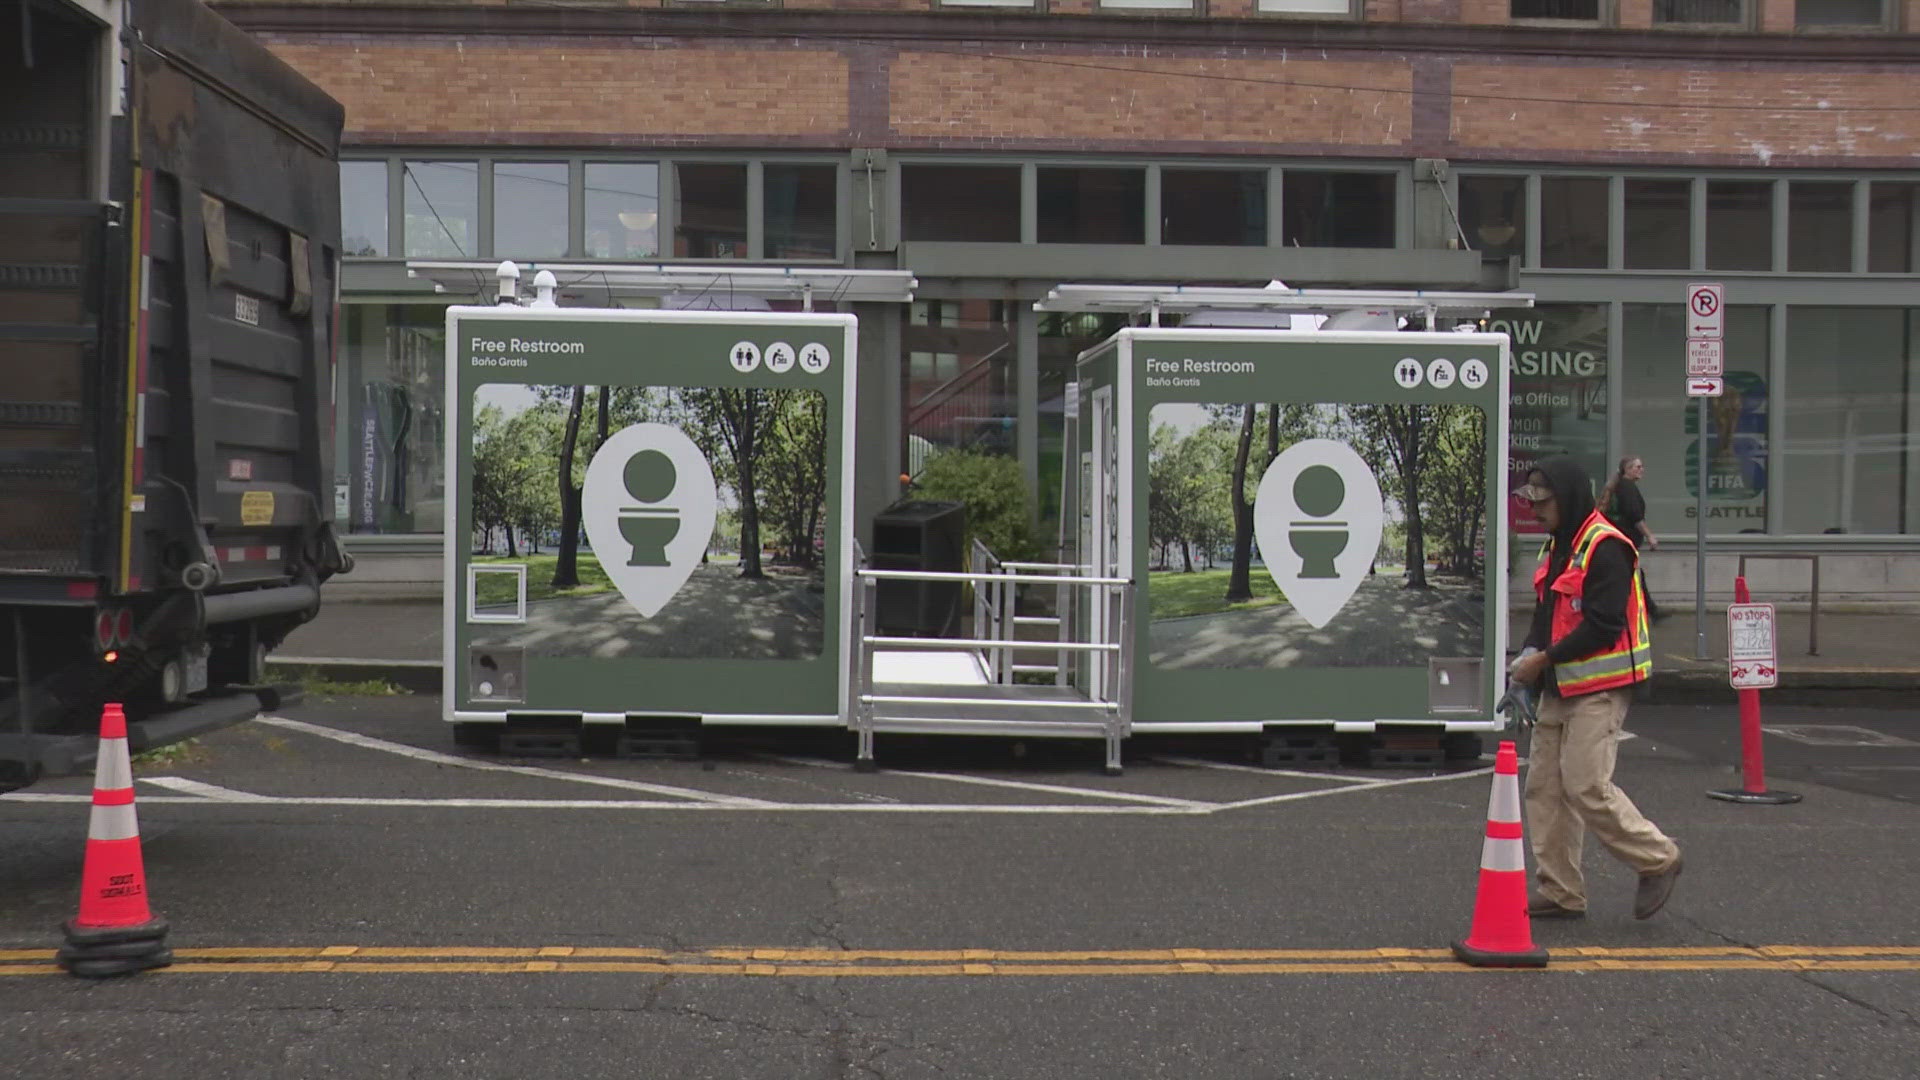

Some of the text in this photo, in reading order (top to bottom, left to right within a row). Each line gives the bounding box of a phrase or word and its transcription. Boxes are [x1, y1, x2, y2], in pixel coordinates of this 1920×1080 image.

[471, 337, 585, 354] Free Restroom
[471, 356, 528, 367] Baño Gratis
[1146, 358, 1255, 372] Free Restroom
[1146, 377, 1201, 387] Baño Gratis
[1525, 392, 1569, 406] Office
[1707, 474, 1745, 489] FIFA
[1732, 611, 1742, 621] NO
